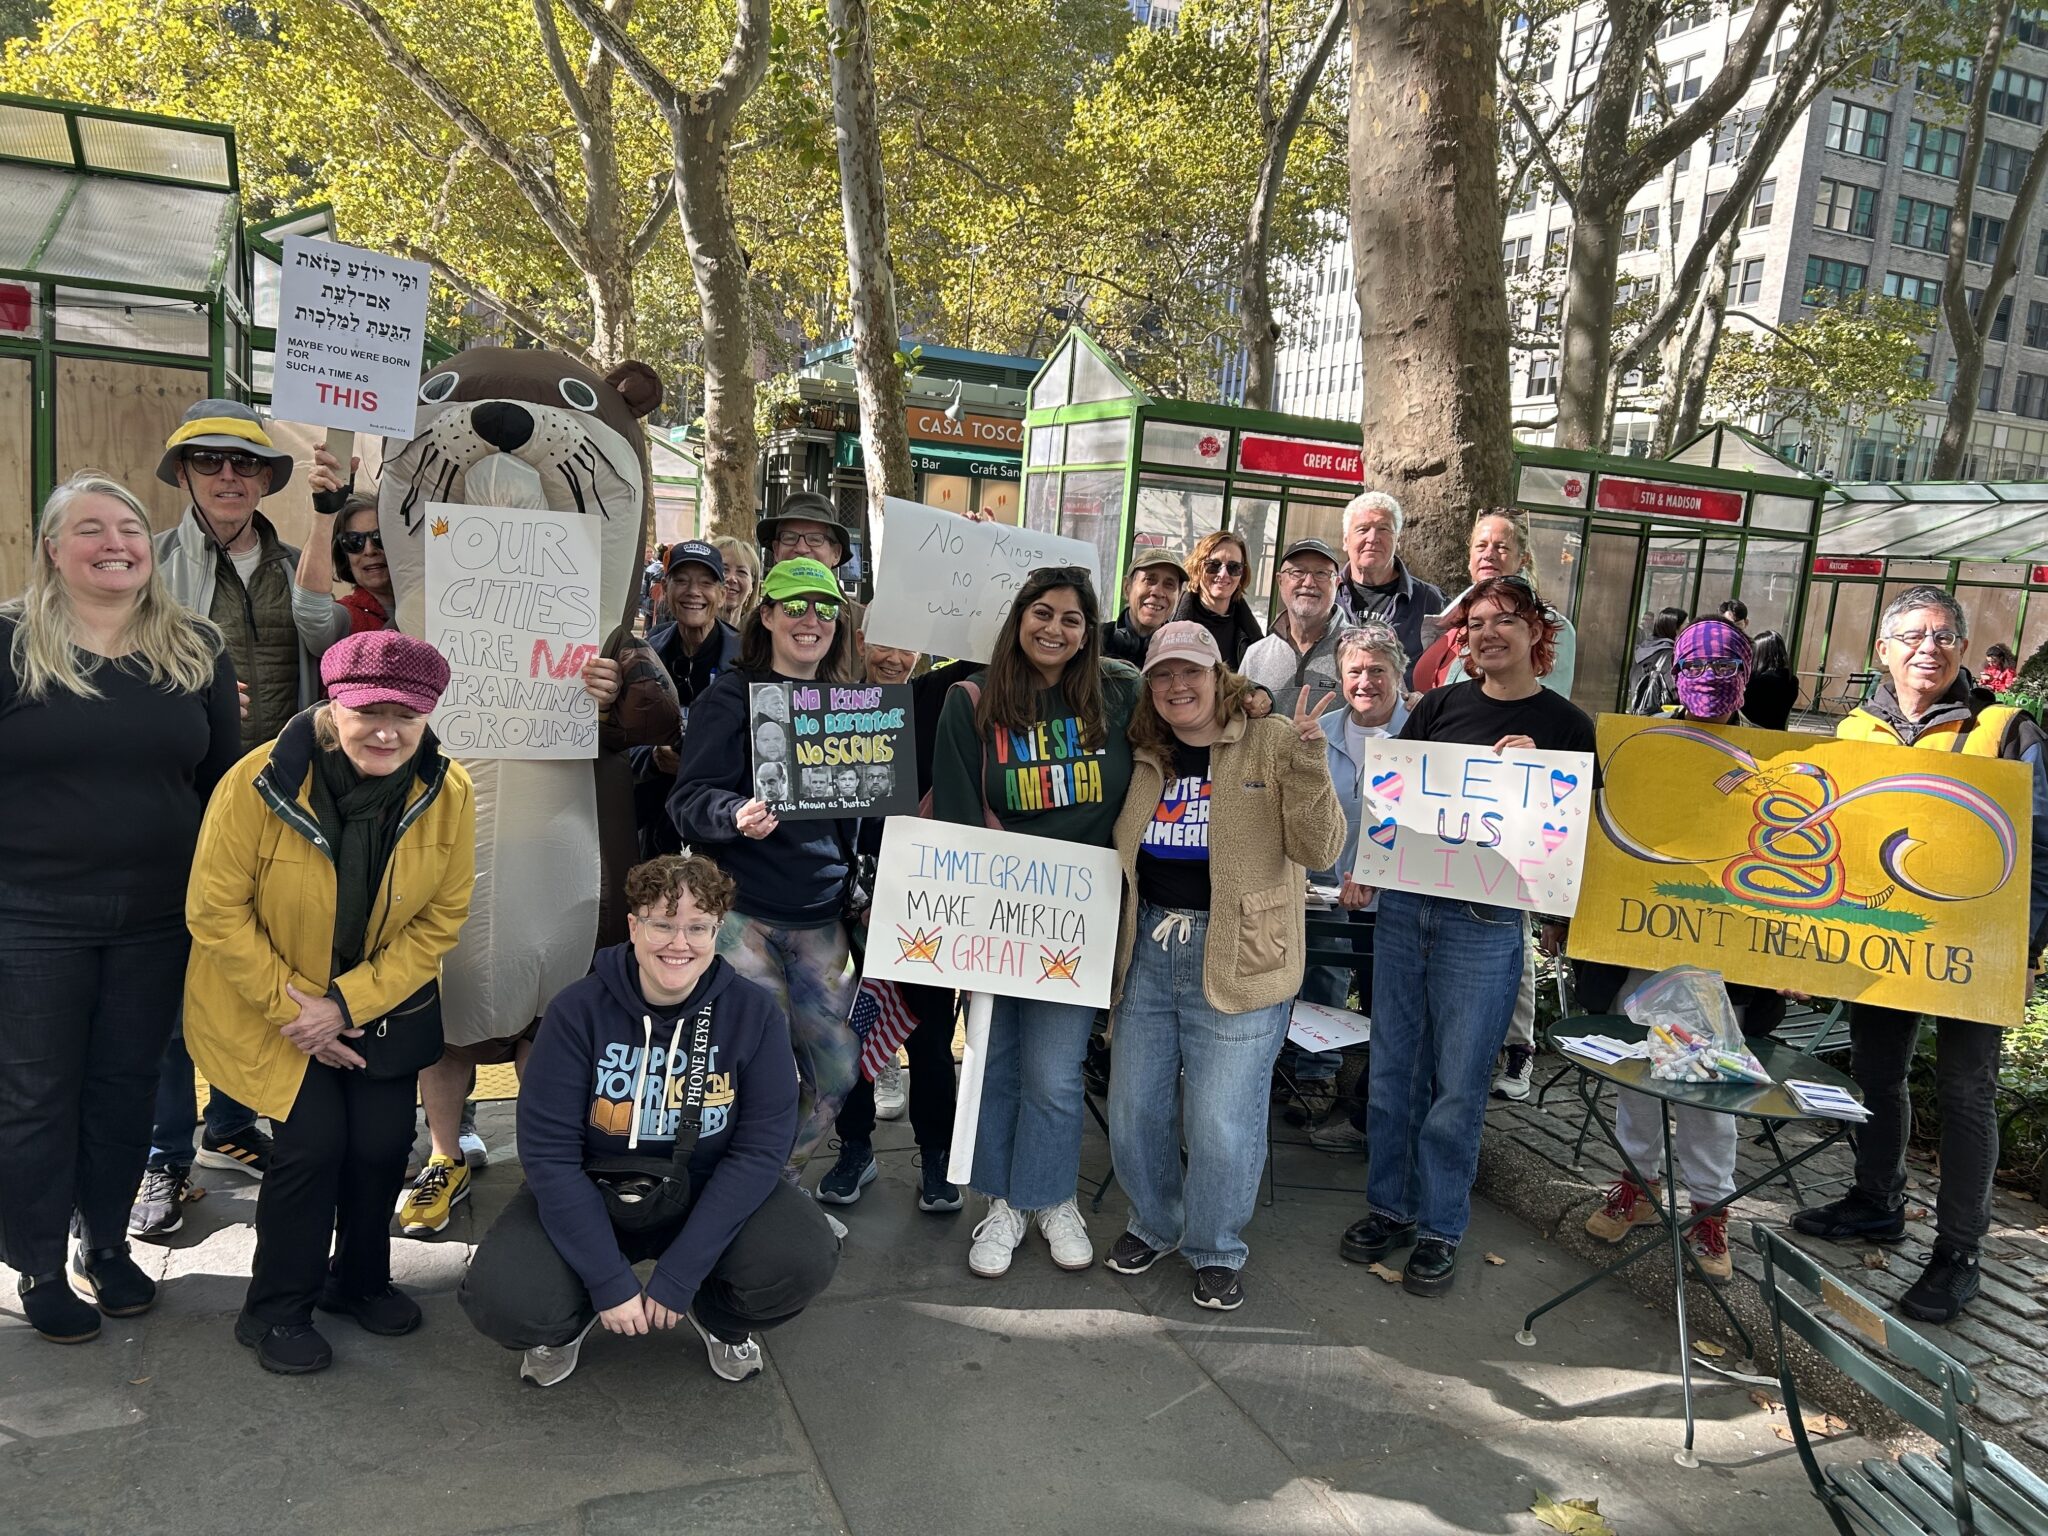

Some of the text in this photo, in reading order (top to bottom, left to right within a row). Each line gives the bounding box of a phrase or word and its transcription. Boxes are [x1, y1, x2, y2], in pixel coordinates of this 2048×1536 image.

[287, 348, 309, 359] FOR
[288, 337, 410, 367] MAYBE YOU WERE BORN
[286, 361, 369, 383] SUCH A TIME AS
[316, 383, 378, 412] THIS
[918, 416, 964, 437] CASA
[1202, 442, 1217, 451] S32
[1303, 453, 1358, 472] CREPE CAFÉ
[922, 458, 941, 470] Bar
[970, 462, 997, 476] Craft
[1640, 491, 1702, 511] 5TH & MADISON
[451, 516, 579, 577] OUR
[919, 520, 963, 554] No
[991, 531, 1043, 567] Kings
[990, 573, 1024, 590] Pre
[439, 578, 597, 638] CITIES
[437, 629, 599, 680] ARE NOT
[442, 672, 596, 719] TRAINING
[793, 686, 882, 711] NO KINGS
[437, 711, 599, 750] GROUNDS
[794, 708, 905, 736] NO DICTATORS
[1005, 760, 1102, 811] AMERICA
[1422, 754, 1546, 808] LET
[778, 800, 796, 811] also
[1141, 821, 1209, 847] AMERI
[1438, 808, 1504, 848] US
[908, 843, 1093, 902] IMMIGRANTS
[1398, 847, 1545, 904] LIVE
[907, 890, 1086, 945] MAKE AMERICA
[952, 933, 1033, 978] GREAT
[1616, 898, 1974, 985] DON'T TREAD ON US
[693, 1018, 710, 1054] KEYS
[599, 1042, 719, 1075] SUPPOT
[687, 1055, 707, 1107] PHONE
